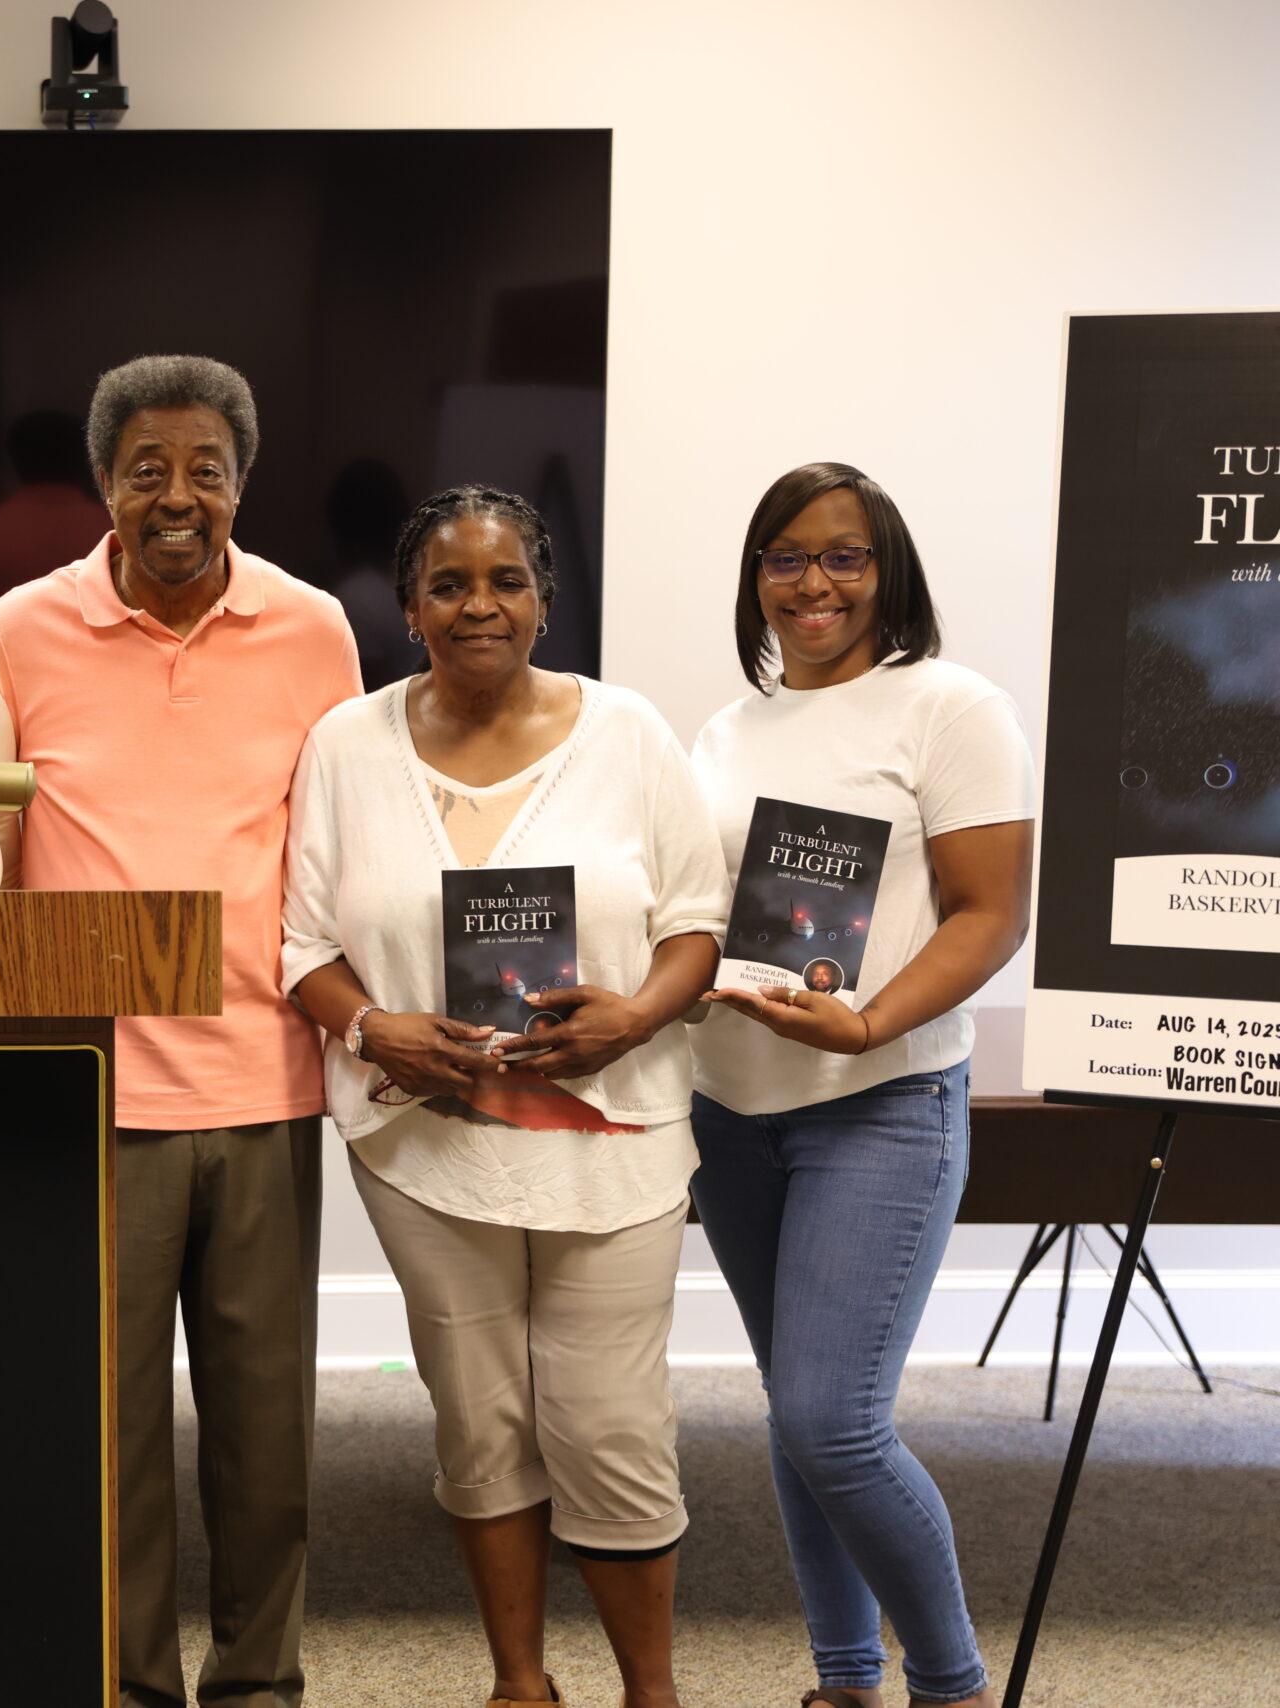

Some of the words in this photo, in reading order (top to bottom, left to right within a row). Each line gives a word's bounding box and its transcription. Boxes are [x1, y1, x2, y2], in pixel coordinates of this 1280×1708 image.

[1213, 446, 1280, 476] TU
[1231, 563, 1272, 582] with
[816, 824, 826, 835] A
[777, 831, 861, 857] TURBULENT
[767, 845, 863, 880] FLIGHT
[504, 883, 514, 893] A
[777, 870, 791, 880] with
[797, 873, 820, 886] Smooth
[819, 877, 846, 891] Landing
[468, 896, 551, 910] TURBULENT
[464, 911, 557, 933] FLIGHT
[476, 936, 491, 944] with
[497, 936, 519, 944] Smooth
[520, 935, 544, 944] Landing
[745, 964, 788, 980] RANDOLPH
[1090, 1014, 1133, 1030] Date:
[1156, 1014, 1196, 1033] AUG
[1207, 1017, 1230, 1039] 14,
[1173, 1045, 1226, 1065] BOOK
[1088, 1059, 1163, 1077] Location:
[1166, 1066, 1236, 1094] Warren
[1240, 1071, 1280, 1097] Cou
